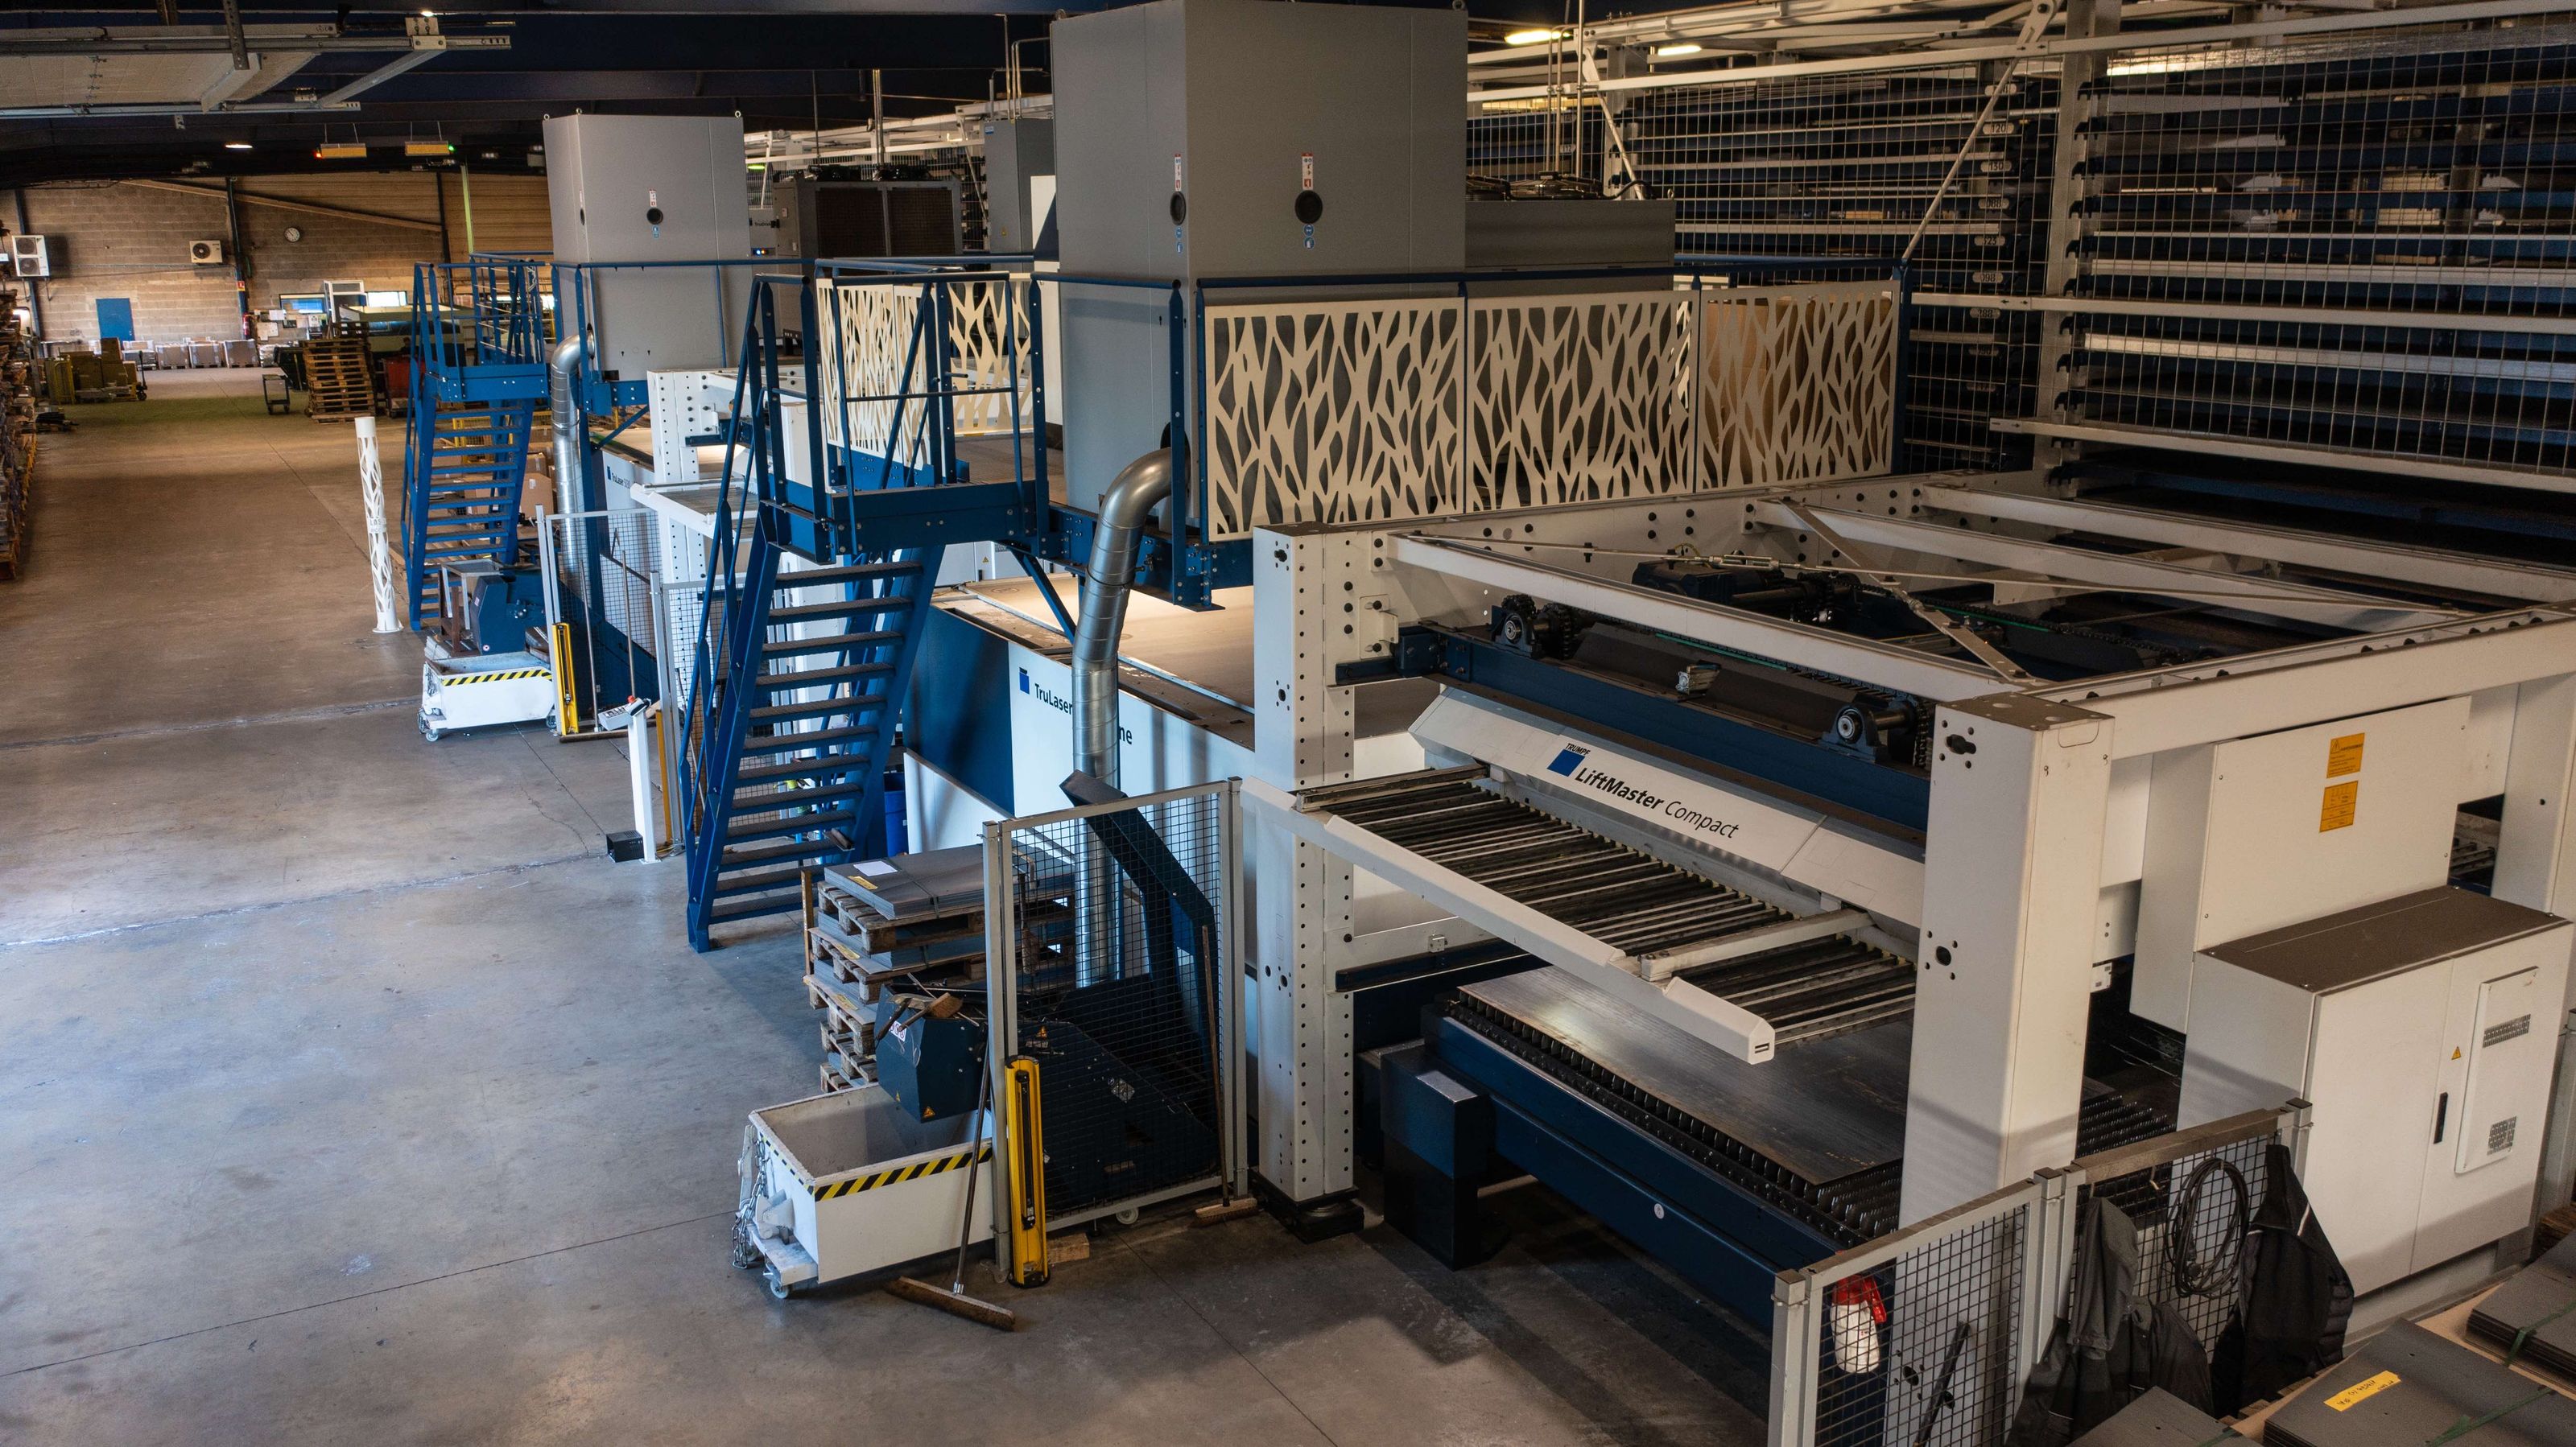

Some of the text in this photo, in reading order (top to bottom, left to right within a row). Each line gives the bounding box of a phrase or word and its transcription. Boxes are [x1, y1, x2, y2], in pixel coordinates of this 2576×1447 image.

[1992, 124, 2006, 134] 120
[1988, 162, 2004, 171] 130
[1034, 683, 1072, 715] TruLaser
[1565, 743, 1591, 756] TRUMPF
[1575, 768, 1740, 839] LiftMaster Compact
